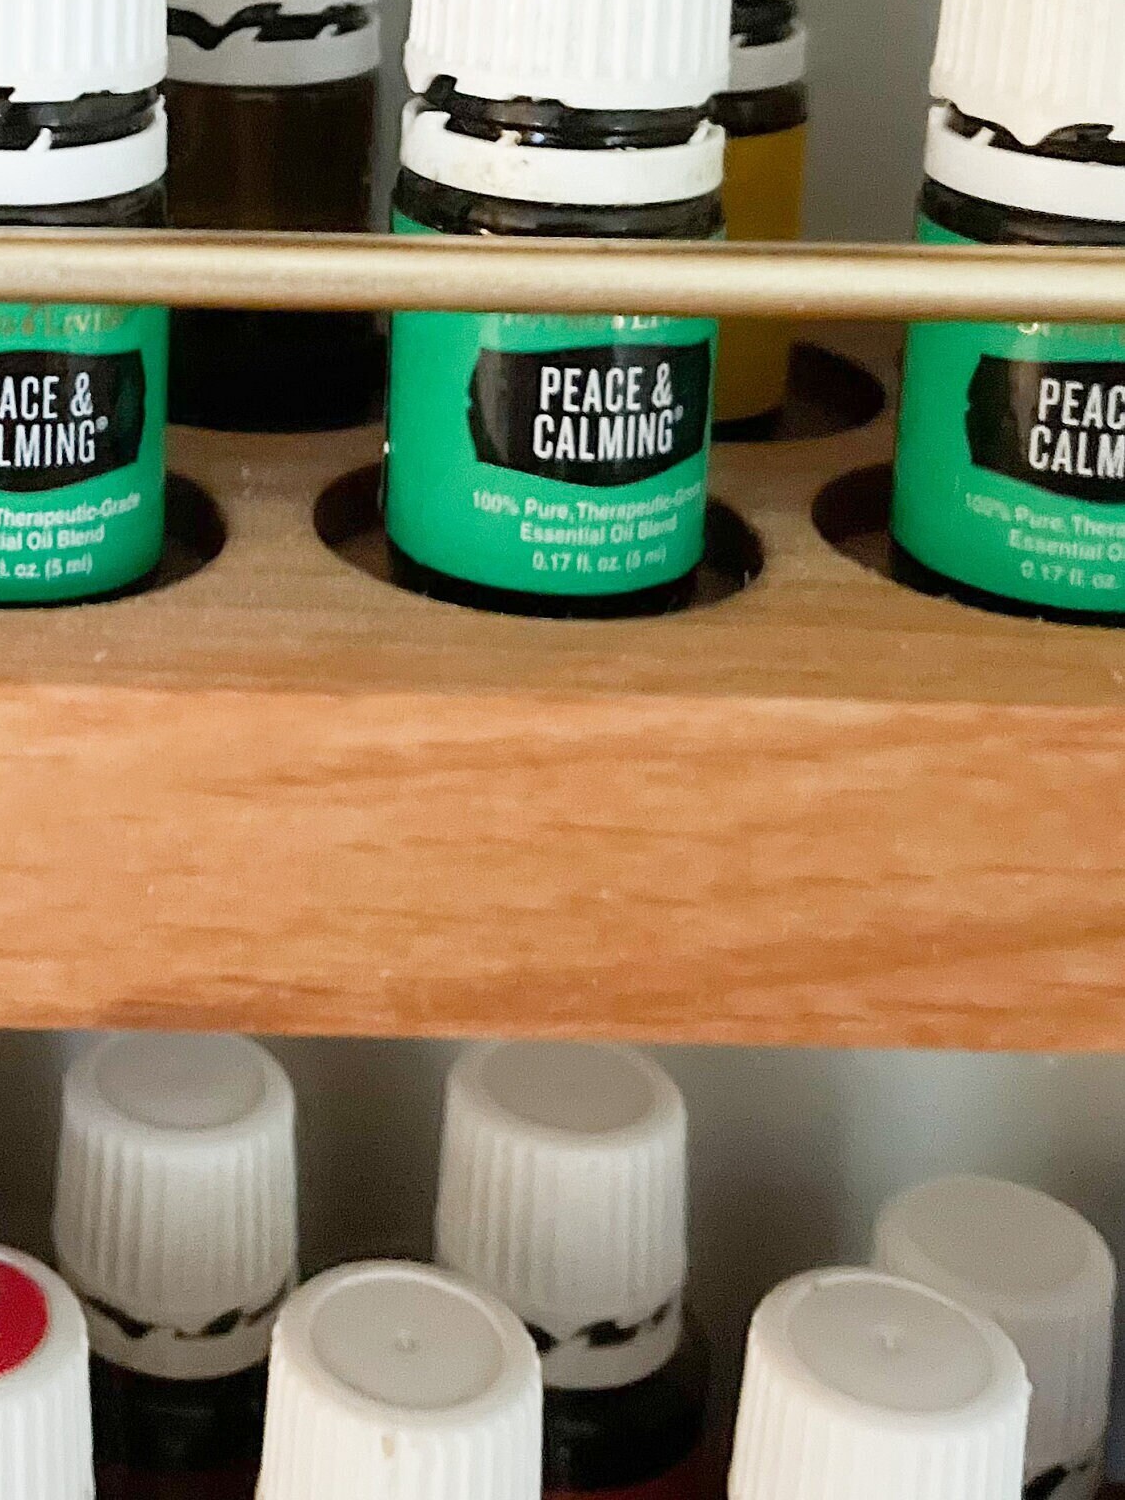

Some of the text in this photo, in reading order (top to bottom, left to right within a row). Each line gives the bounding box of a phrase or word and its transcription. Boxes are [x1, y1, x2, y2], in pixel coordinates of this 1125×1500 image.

[70, 371, 93, 417] &
[539, 362, 673, 414] PEACE &
[473, 490, 520, 516] 100%
[26, 528, 53, 550] Oil
[57, 524, 105, 549] Blend
[520, 521, 606, 546] Essential
[610, 523, 635, 544] Oil
[45, 557, 63, 581] (5
[532, 550, 572, 572] 0.17
